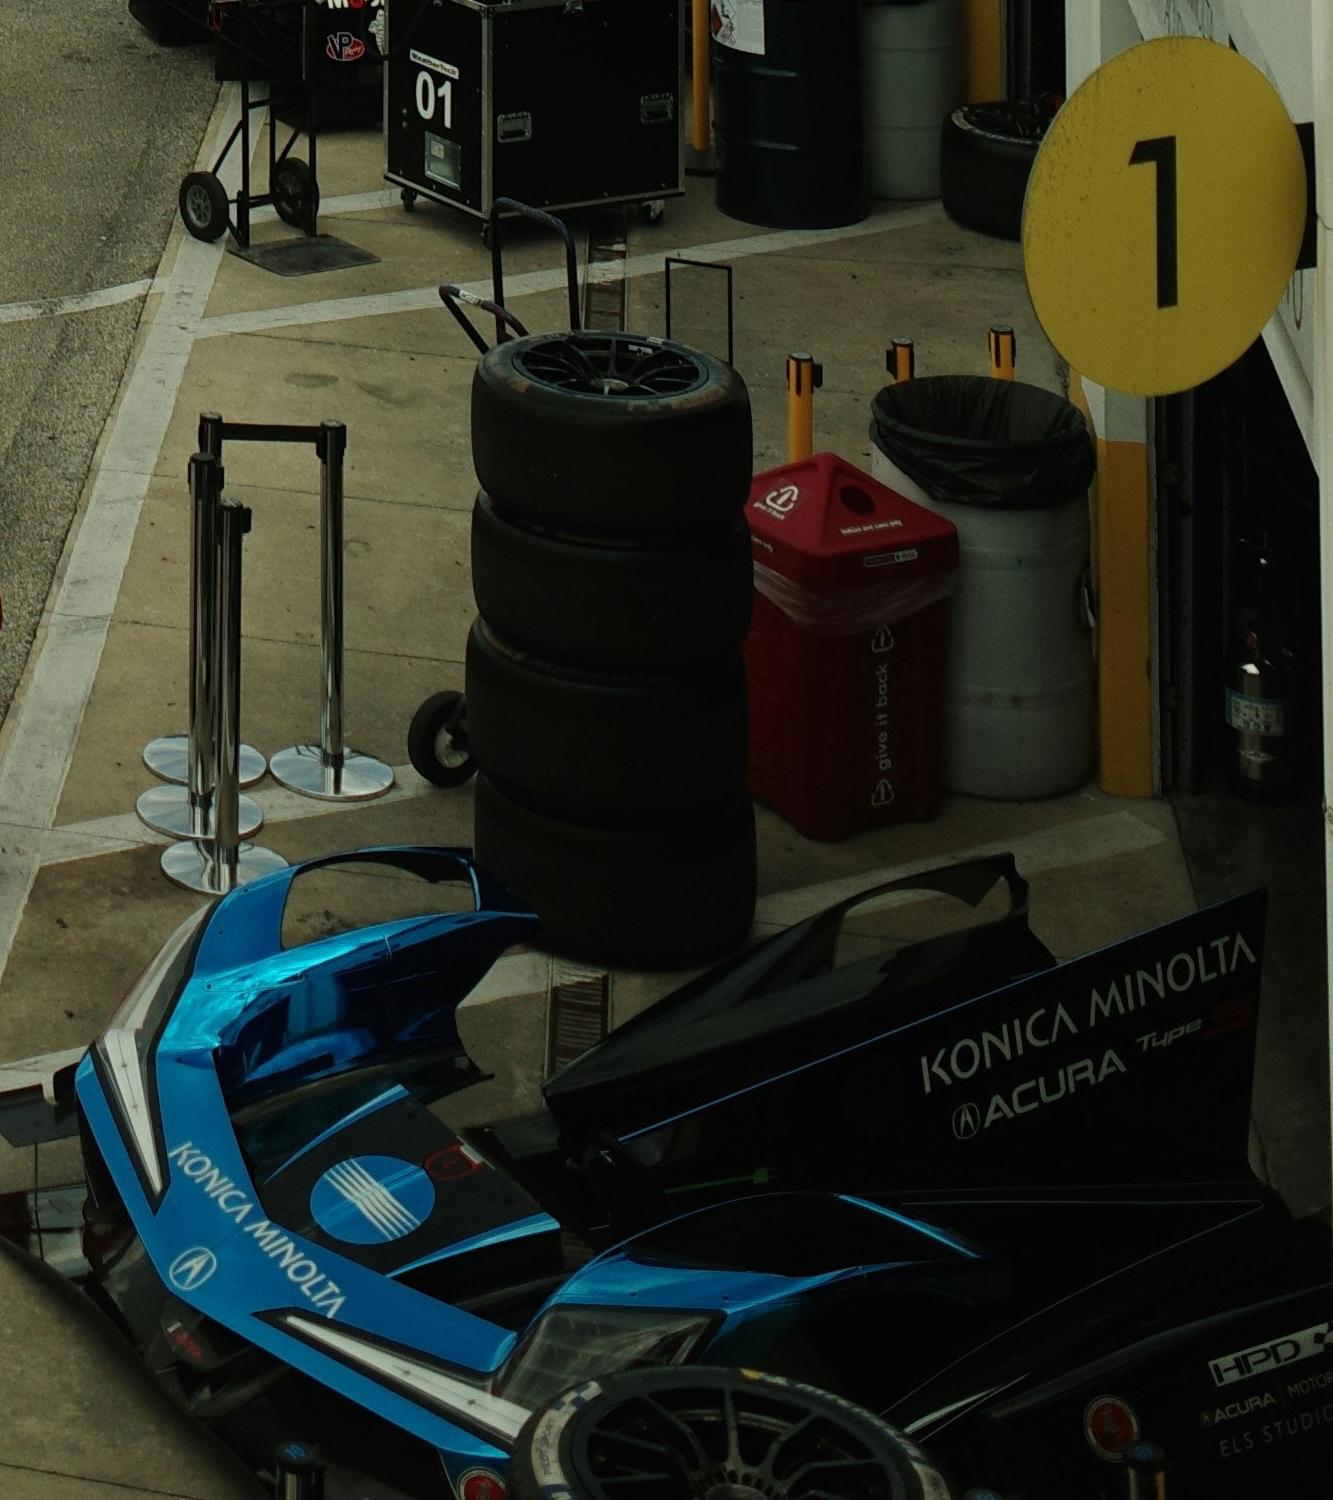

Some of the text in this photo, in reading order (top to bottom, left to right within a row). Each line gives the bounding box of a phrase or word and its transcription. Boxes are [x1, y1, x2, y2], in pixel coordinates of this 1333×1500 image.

[415, 69, 453, 130] 01
[1129, 136, 1179, 310] 1
[875, 663, 892, 771] give it back
[919, 931, 1257, 1095] KONICA MINOLTA
[983, 1048, 1129, 1129] ACURA
[1135, 1018, 1204, 1052] Type
[169, 1141, 347, 1320] KONICA MINOLTA
[1213, 1338, 1301, 1384] HPD
[1214, 1392, 1276, 1424] ACURA
[1219, 1431, 1254, 1459] ELS
